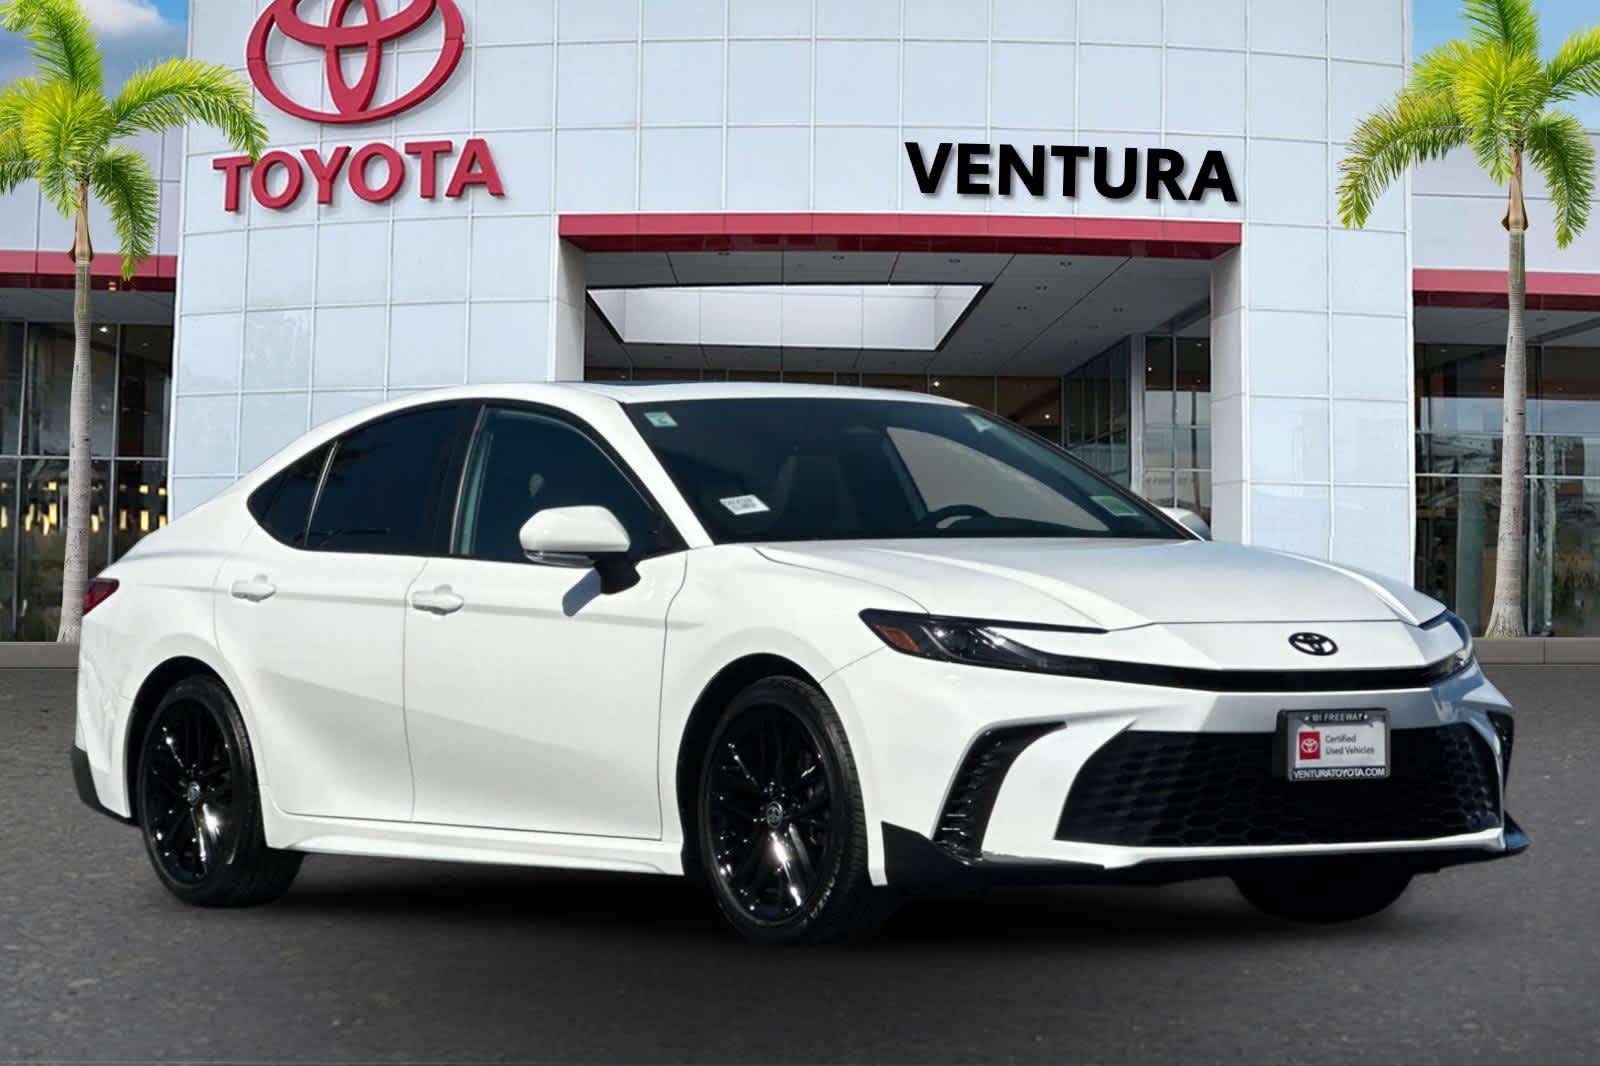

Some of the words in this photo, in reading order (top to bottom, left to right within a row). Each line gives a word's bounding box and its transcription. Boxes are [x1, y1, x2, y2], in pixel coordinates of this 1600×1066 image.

[213, 139, 504, 212] TOYOTA
[905, 142, 1239, 203] VENTURA
[1323, 711, 1362, 721] FREEWAY
[1325, 734, 1357, 743] Certified
[1326, 746, 1343, 755] Used
[1345, 744, 1375, 755] Vehicles
[1294, 767, 1385, 779] VENTURATOYOTA.COM
